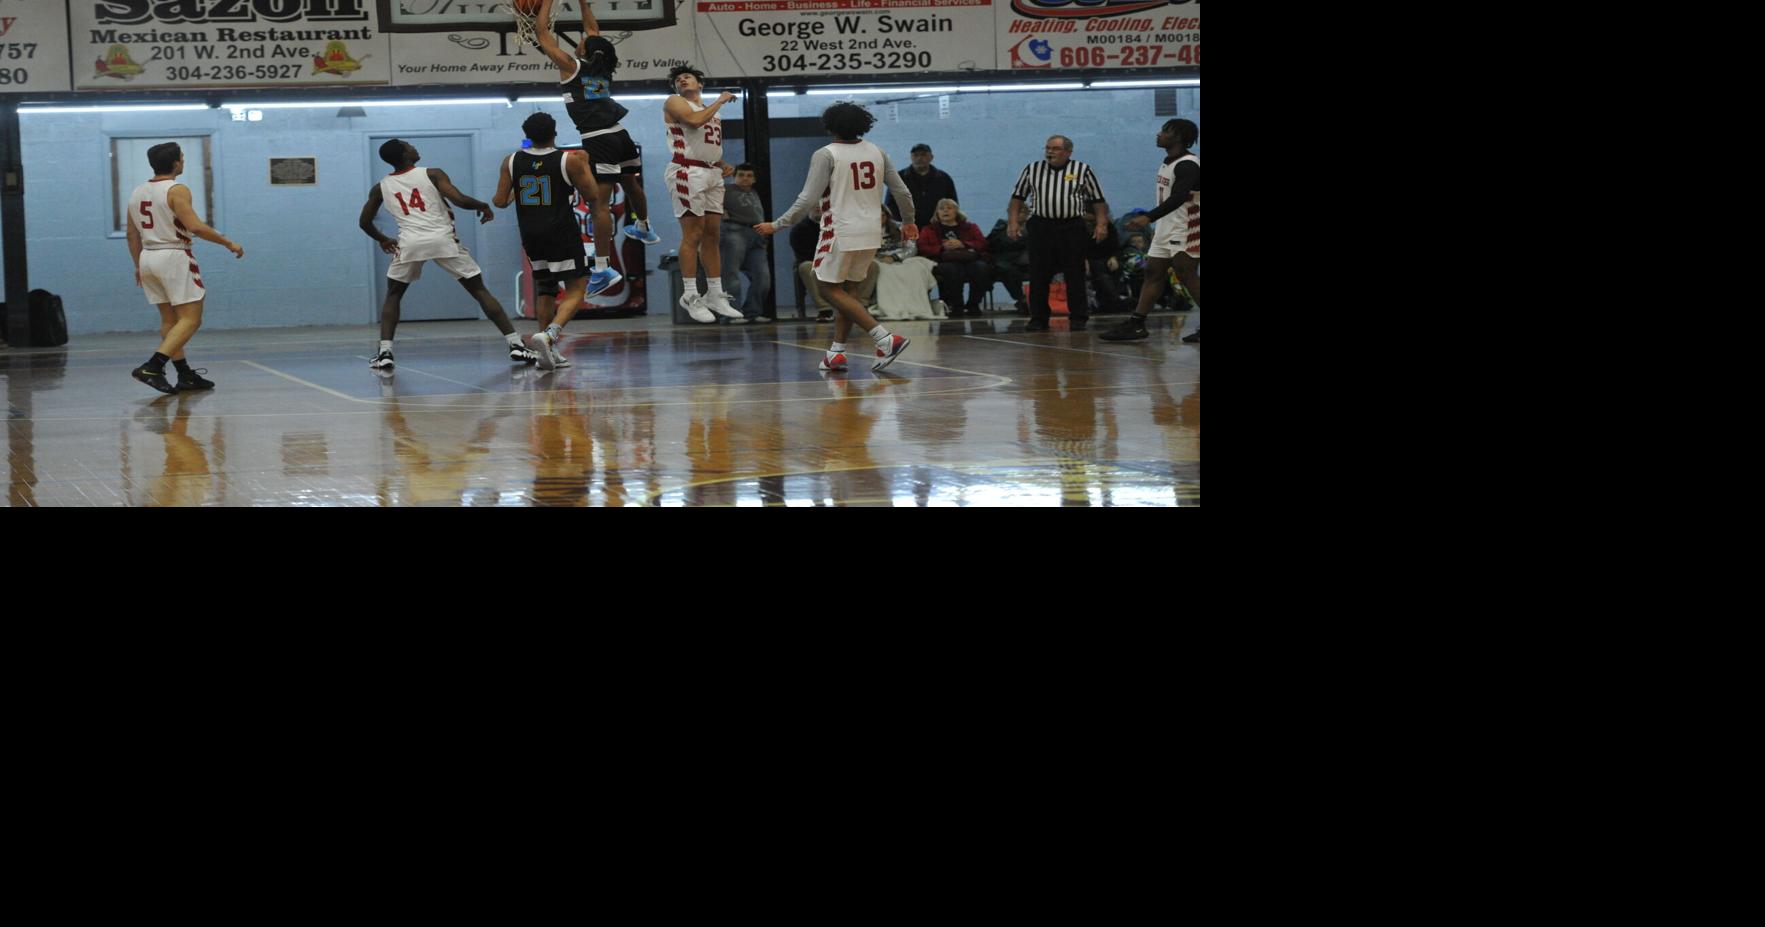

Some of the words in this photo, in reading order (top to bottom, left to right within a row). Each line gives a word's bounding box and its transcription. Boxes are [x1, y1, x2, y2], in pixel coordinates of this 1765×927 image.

[708, 3, 736, 11] Auto
[745, 2, 777, 10] Home
[787, 0, 838, 9] Business
[850, 0, 871, 8] Life
[89, 29, 208, 44] Mexican
[216, 26, 372, 43] Restaurant
[738, 18, 825, 40] George
[834, 15, 867, 34] W.
[877, 14, 953, 34] Swain
[780, 40, 799, 52] 22
[803, 39, 843, 51] West
[848, 38, 878, 50] 2nd
[882, 37, 918, 50] Ave.
[1086, 35, 1142, 45] M00184
[151, 46, 185, 61] 201
[193, 45, 219, 60] W.
[226, 44, 264, 60] 2nd
[271, 43, 316, 59] Ave.
[762, 51, 932, 73] 304-235-3290
[166, 64, 303, 82] 304-236-5927
[398, 64, 428, 74] Your
[430, 63, 467, 73] Home
[469, 63, 504, 74] Away
[507, 61, 541, 72] From
[626, 59, 650, 70] Tug
[652, 57, 691, 69] Valley
[703, 124, 721, 147] 23
[849, 161, 880, 191] 13
[519, 174, 552, 206] 21
[395, 188, 426, 216] 14
[139, 200, 154, 229] 5
